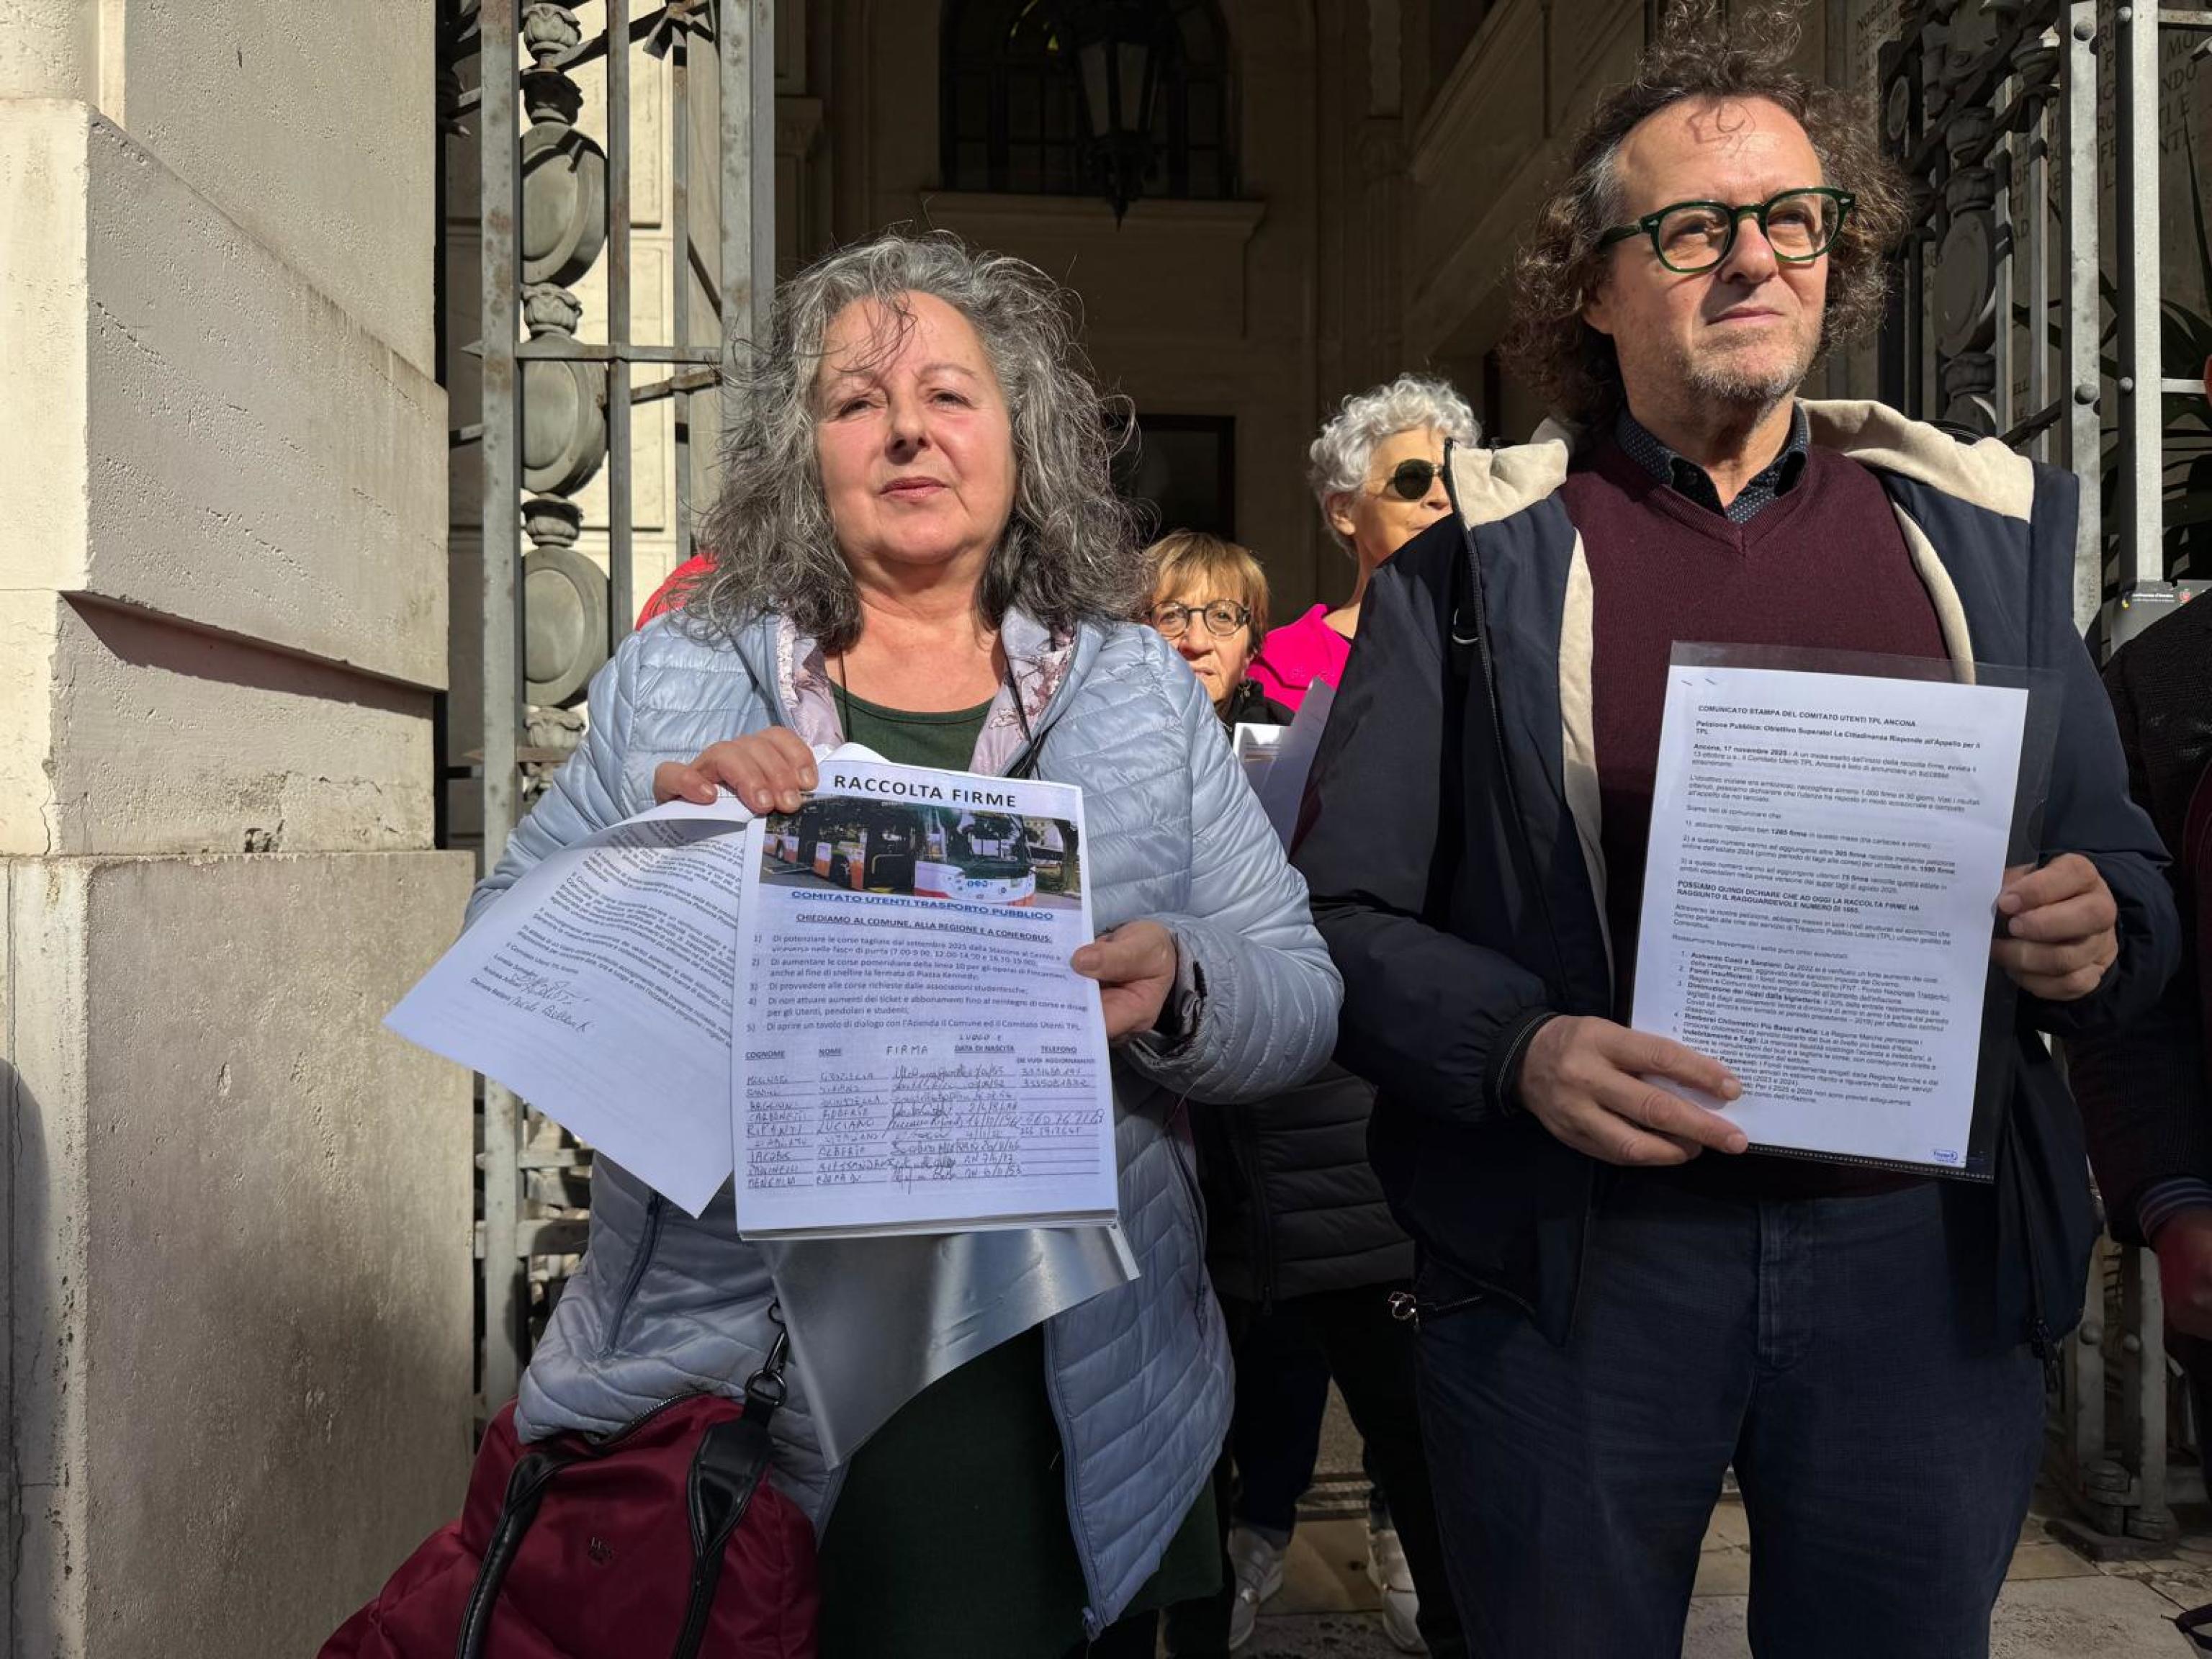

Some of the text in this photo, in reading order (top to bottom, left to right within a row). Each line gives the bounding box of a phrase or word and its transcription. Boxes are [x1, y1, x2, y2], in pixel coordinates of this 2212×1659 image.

[1750, 708, 1780, 716] STAMPA
[1800, 711, 1838, 721] COMITATO
[1884, 719, 1915, 727] ANCONA
[835, 775, 1016, 808] RACCOLTA FIRME
[1678, 881, 1717, 891] POSSIAMO
[791, 891, 1053, 920] COMITATO UTENTI TRASPORTO PUBBLICO
[796, 913, 851, 924] CHIEDIAMO
[938, 924, 977, 933] REGIONE
[886, 1045, 928, 1056] FIRMA
